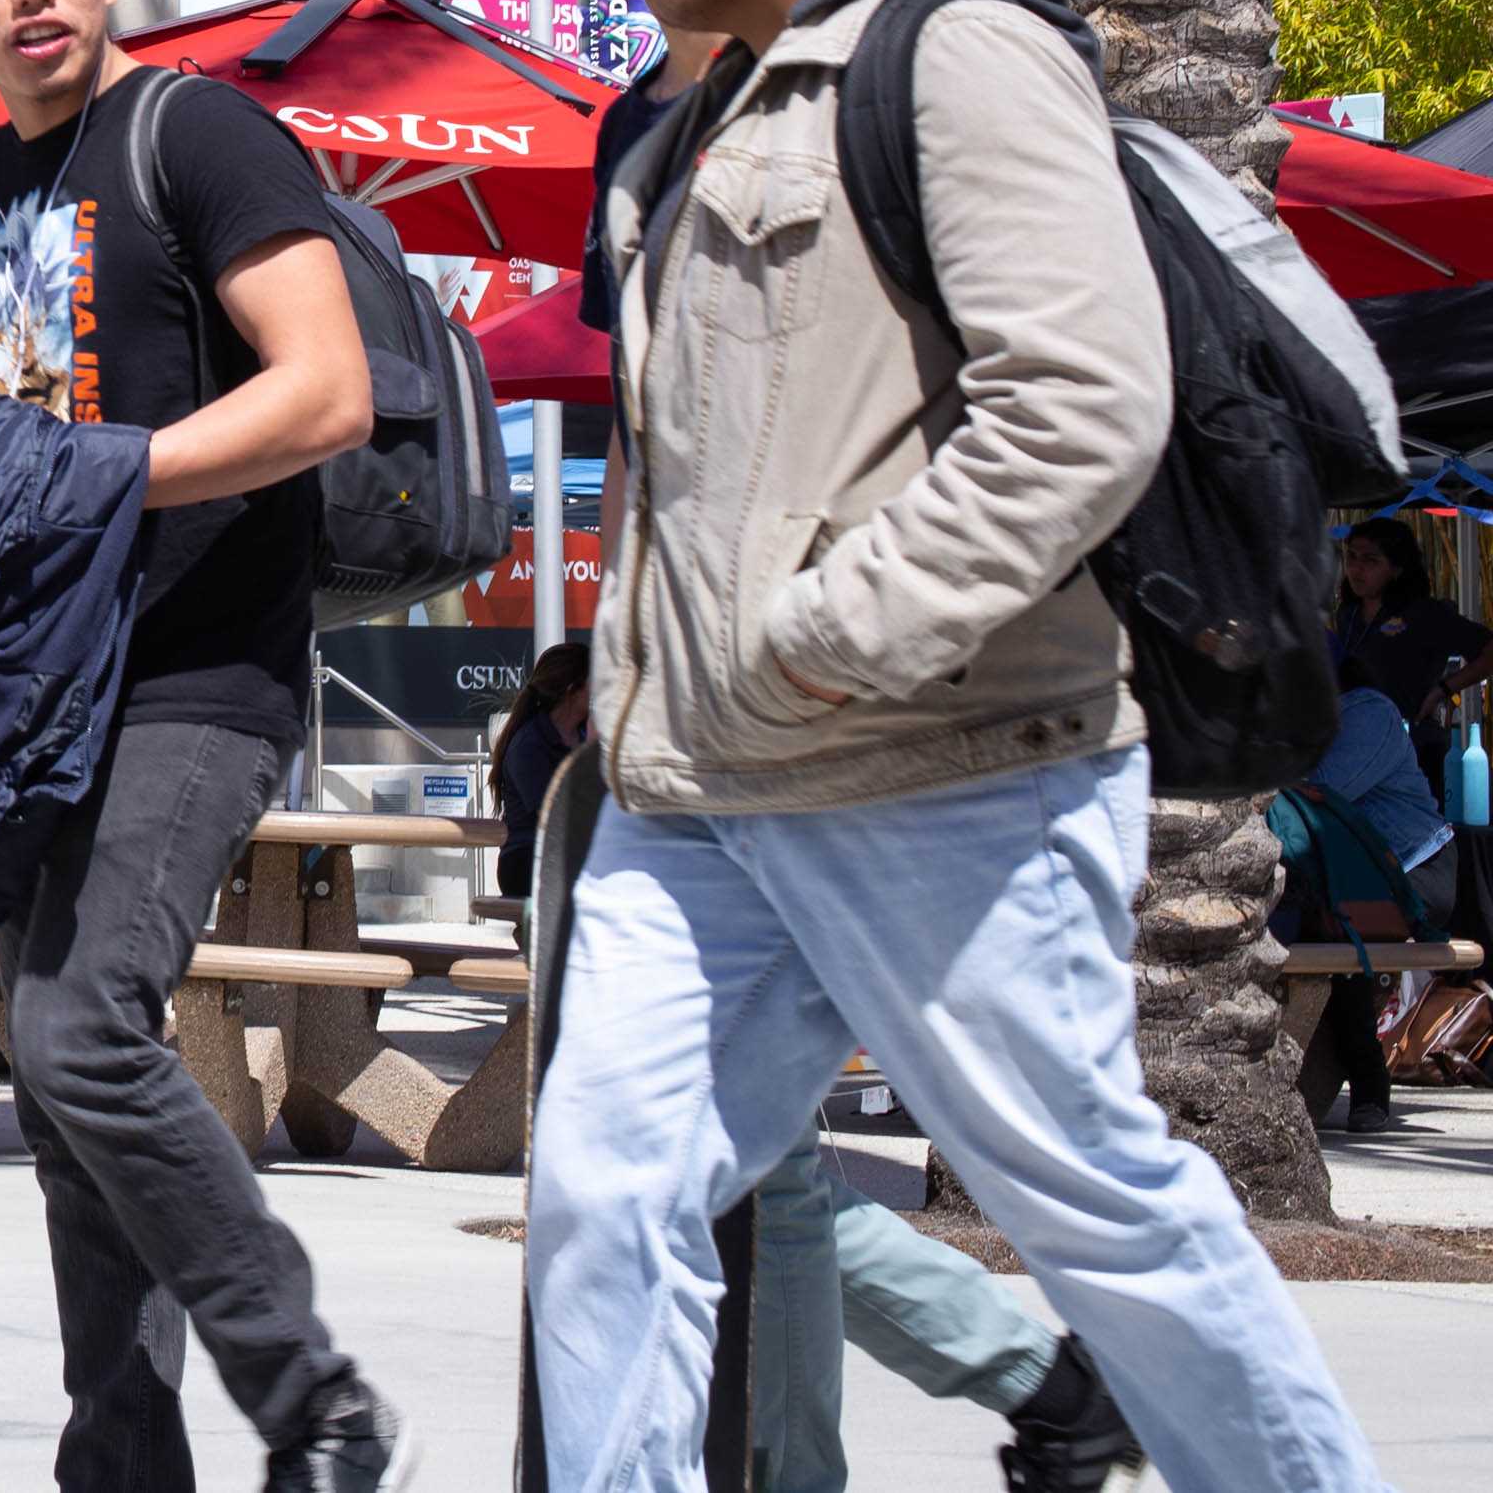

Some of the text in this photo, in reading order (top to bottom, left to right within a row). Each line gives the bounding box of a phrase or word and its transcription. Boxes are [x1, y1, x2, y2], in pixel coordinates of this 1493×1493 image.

[498, 0, 531, 23] TH
[275, 105, 535, 155] CSUN
[73, 199, 99, 340] ULTRA
[508, 271, 532, 284] CEN
[510, 559, 534, 581] AN
[456, 664, 523, 690] CSUN
